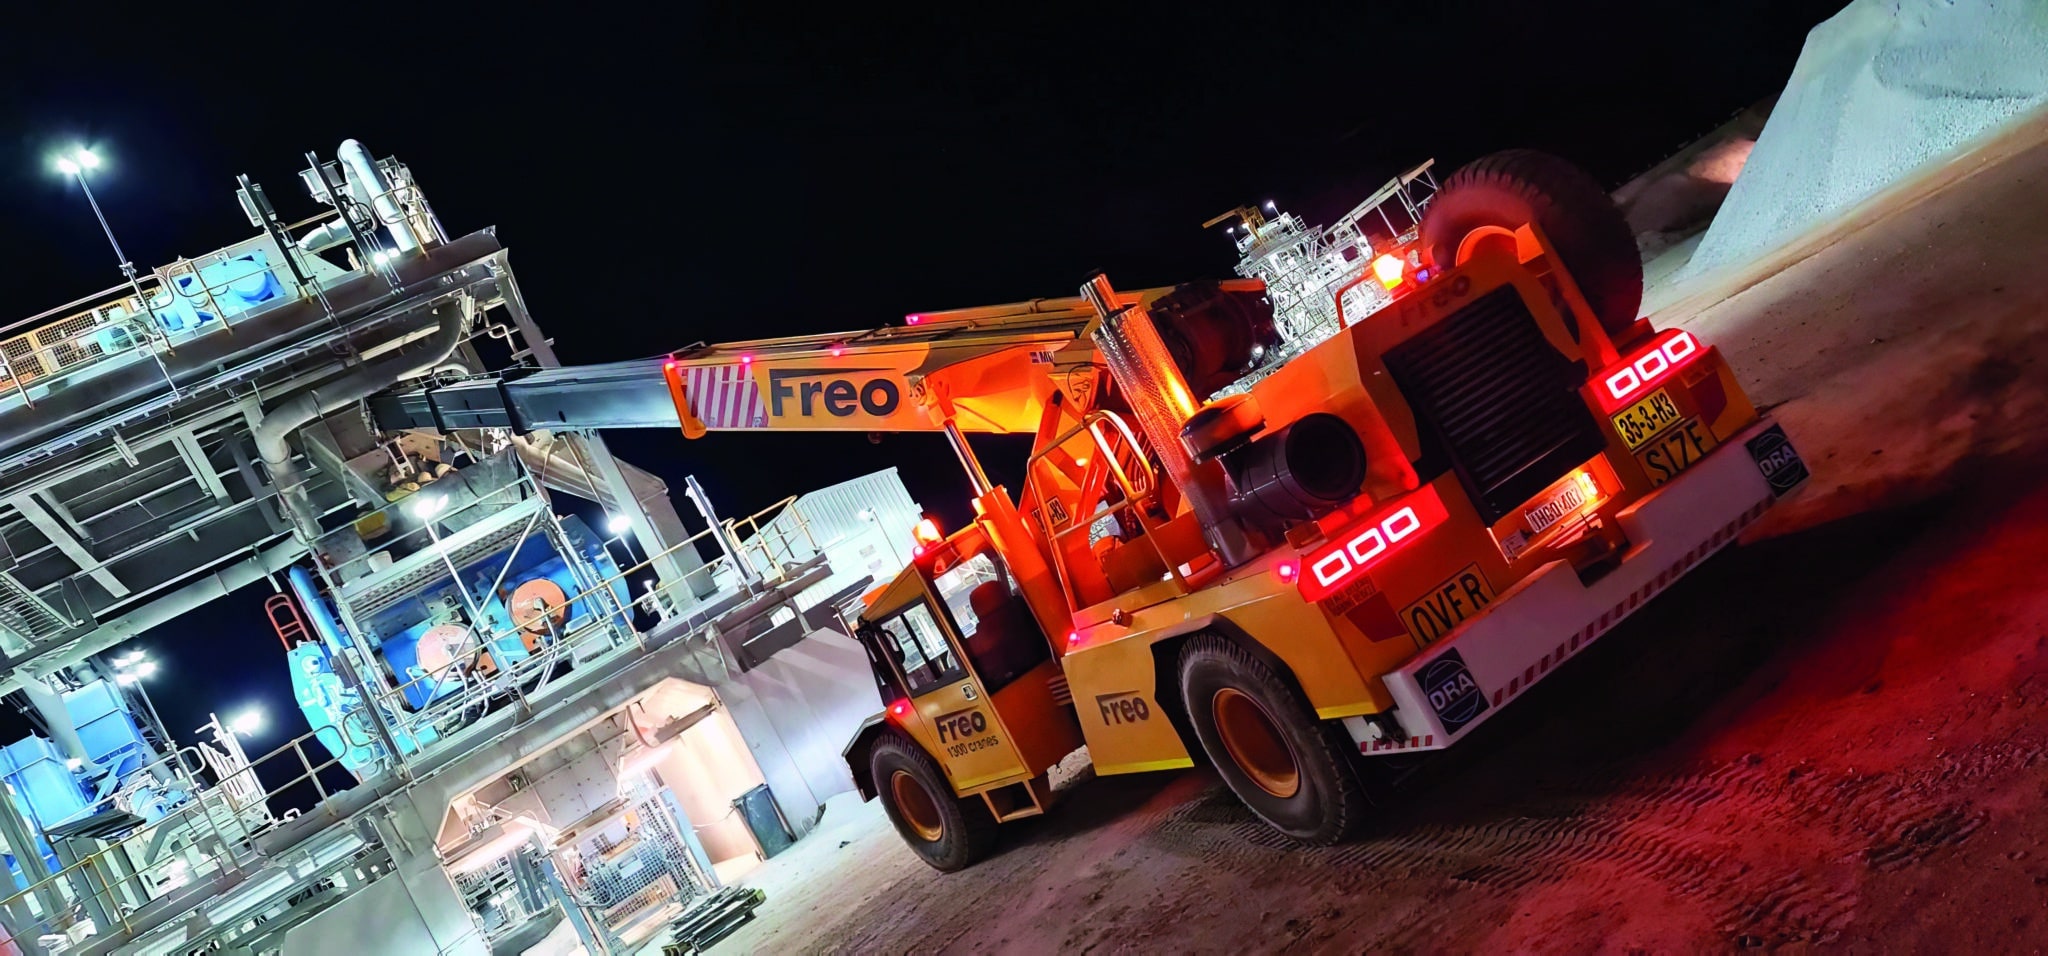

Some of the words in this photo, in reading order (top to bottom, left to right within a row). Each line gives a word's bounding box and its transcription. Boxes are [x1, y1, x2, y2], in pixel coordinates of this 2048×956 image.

[769, 368, 899, 416] Freo
[1618, 391, 1677, 444] 35-3-H3
[1759, 445, 1797, 477] DRA
[1095, 690, 1150, 726] Freo
[1429, 672, 1475, 710] DRA
[934, 705, 987, 744] Freo
[946, 742, 968, 758] 1300
